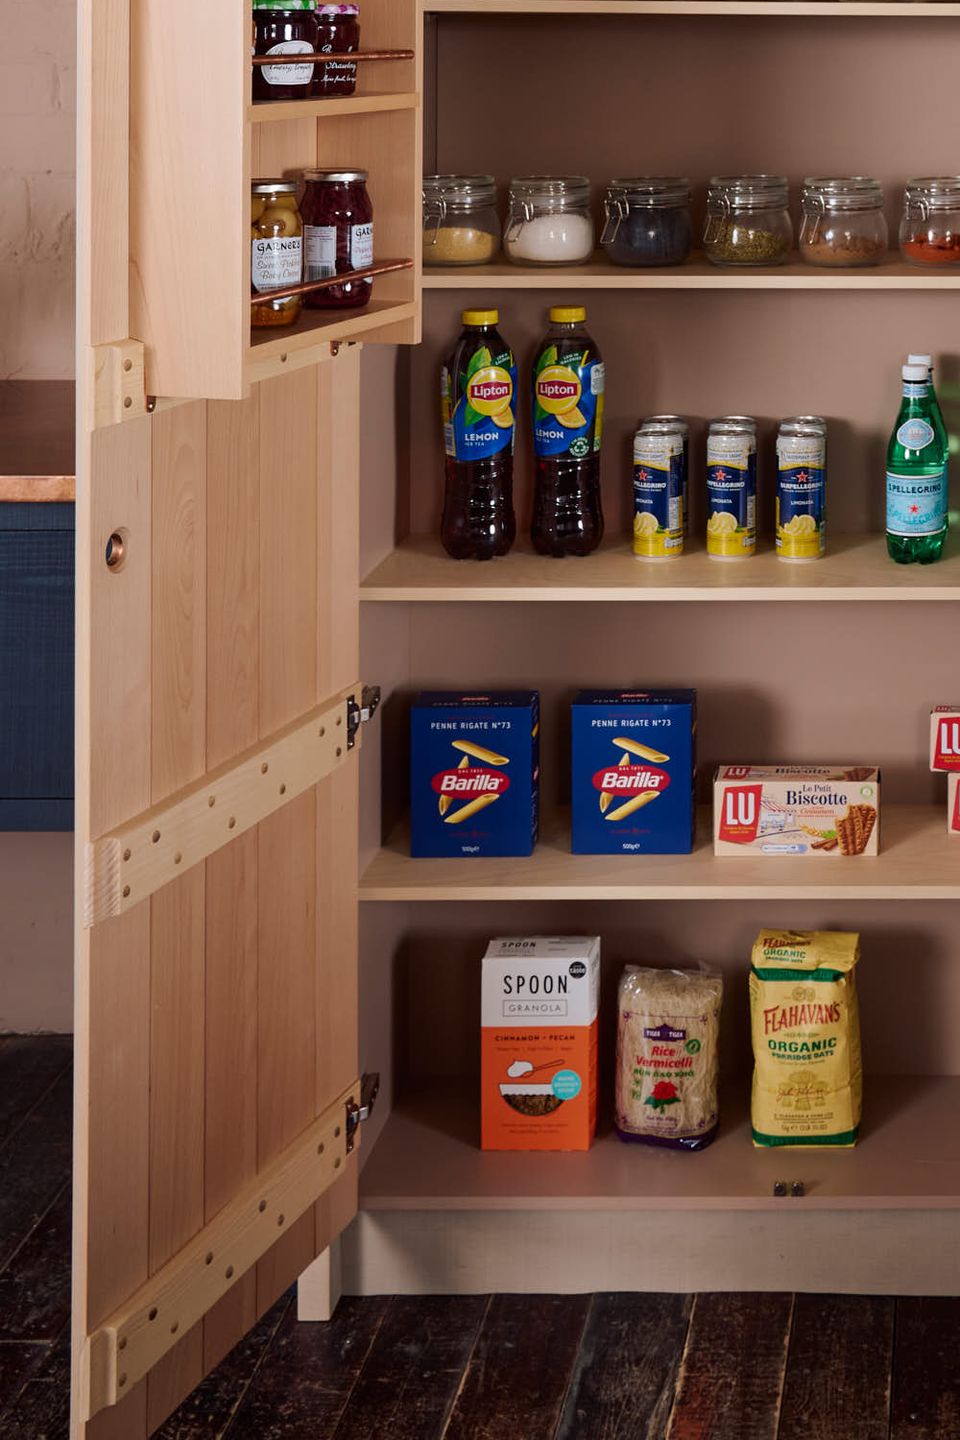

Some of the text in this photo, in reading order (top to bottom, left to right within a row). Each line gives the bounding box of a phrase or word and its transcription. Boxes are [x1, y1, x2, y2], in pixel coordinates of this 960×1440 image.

[473, 385, 508, 399] Lipton
[540, 384, 574, 399] Lipton
[464, 432, 499, 442] LEMON
[535, 429, 564, 439] LEMON
[430, 722, 458, 730] PENNE
[591, 719, 618, 727] PENNE
[621, 719, 649, 727] RIGATE
[440, 774, 500, 791] Barilla
[601, 771, 660, 788] Barilla
[814, 784, 832, 792] Petit
[786, 790, 848, 806] Biscotte
[726, 792, 755, 825] LU
[763, 948, 806, 959] ORGANIC
[503, 974, 568, 994] SPOON
[508, 1004, 561, 1012] GRANOLA
[763, 1001, 842, 1035] FLAHAVAN'S
[652, 1046, 676, 1057] Rice
[768, 1037, 838, 1053] ORGANIC
[636, 1056, 693, 1068] Vermicelli
